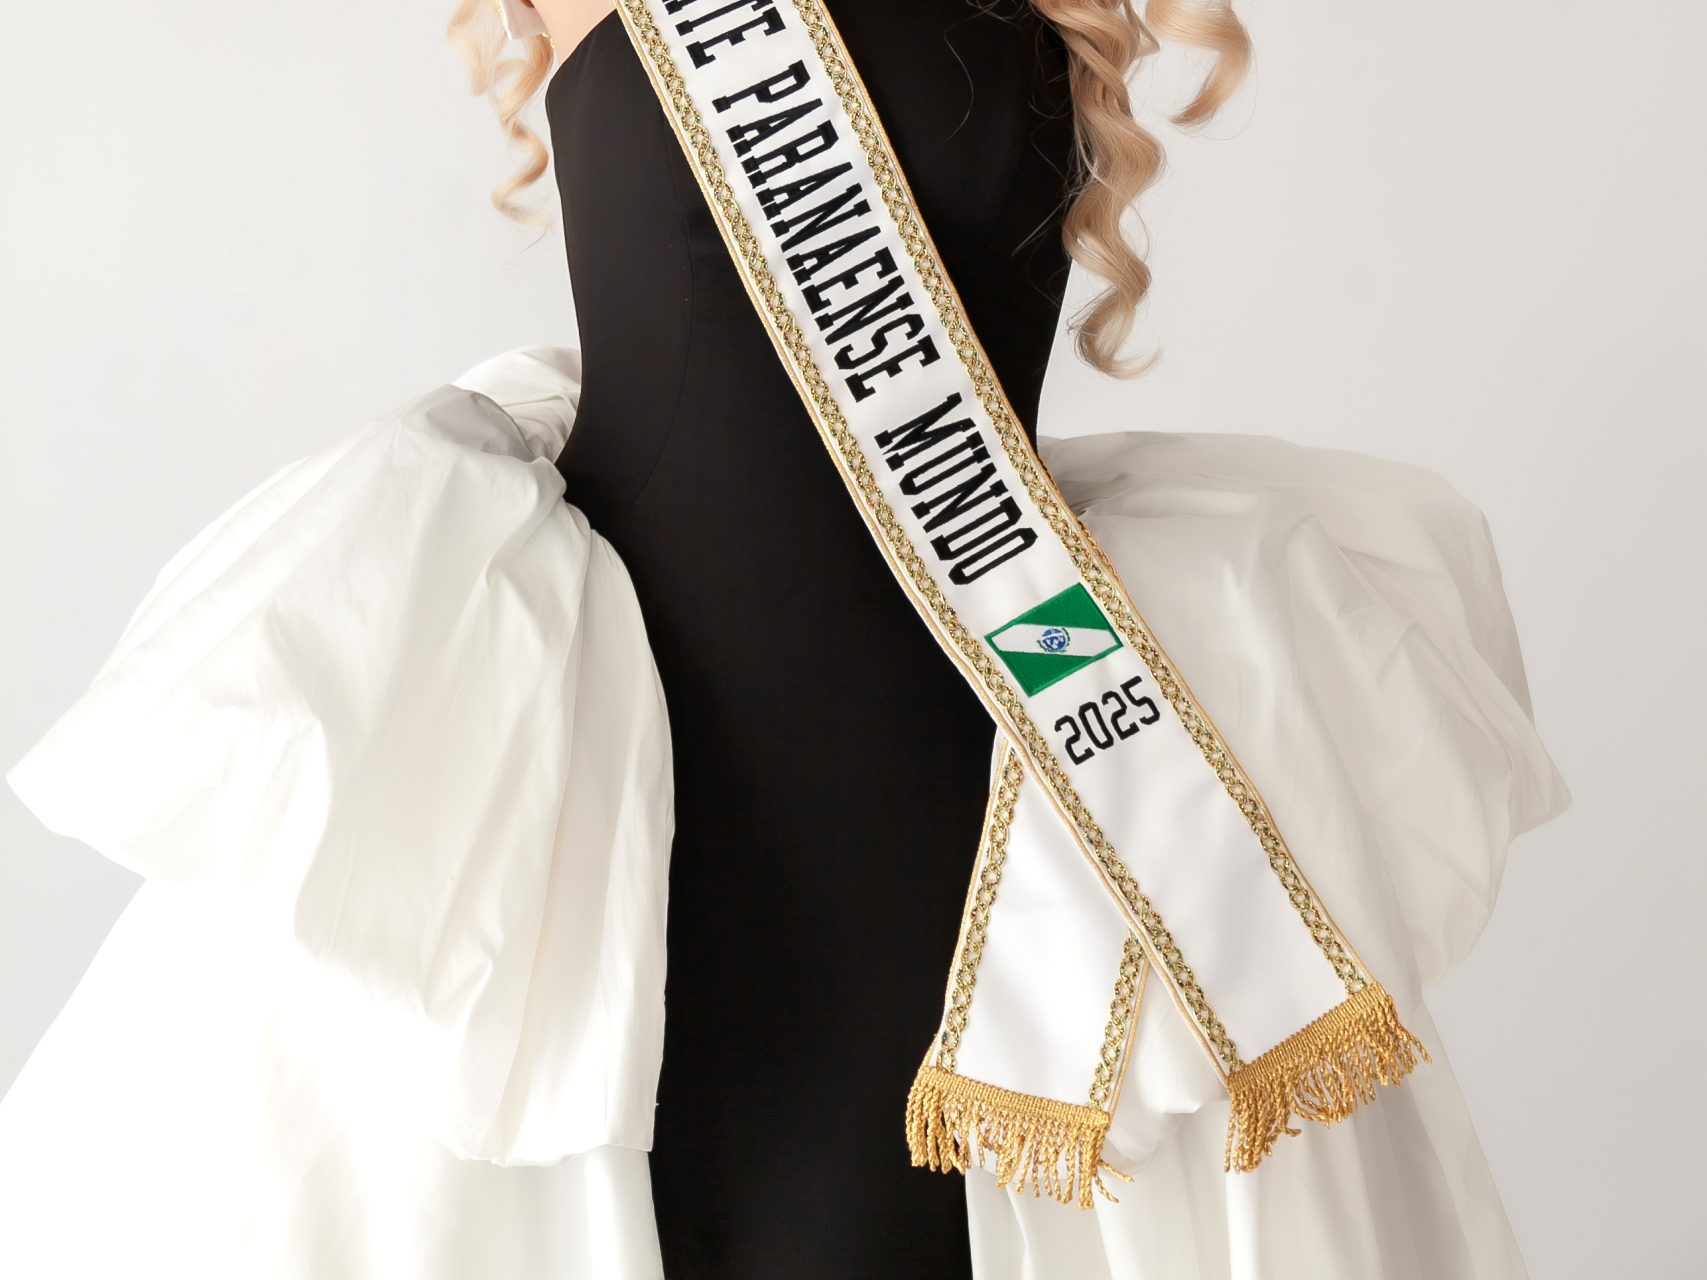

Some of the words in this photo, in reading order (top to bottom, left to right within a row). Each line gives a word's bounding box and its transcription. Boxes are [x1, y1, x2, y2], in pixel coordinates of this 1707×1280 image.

[712, 59, 940, 403] PARANAENSE
[874, 392, 1038, 585] MUNDO
[1054, 675, 1160, 765] 2025
